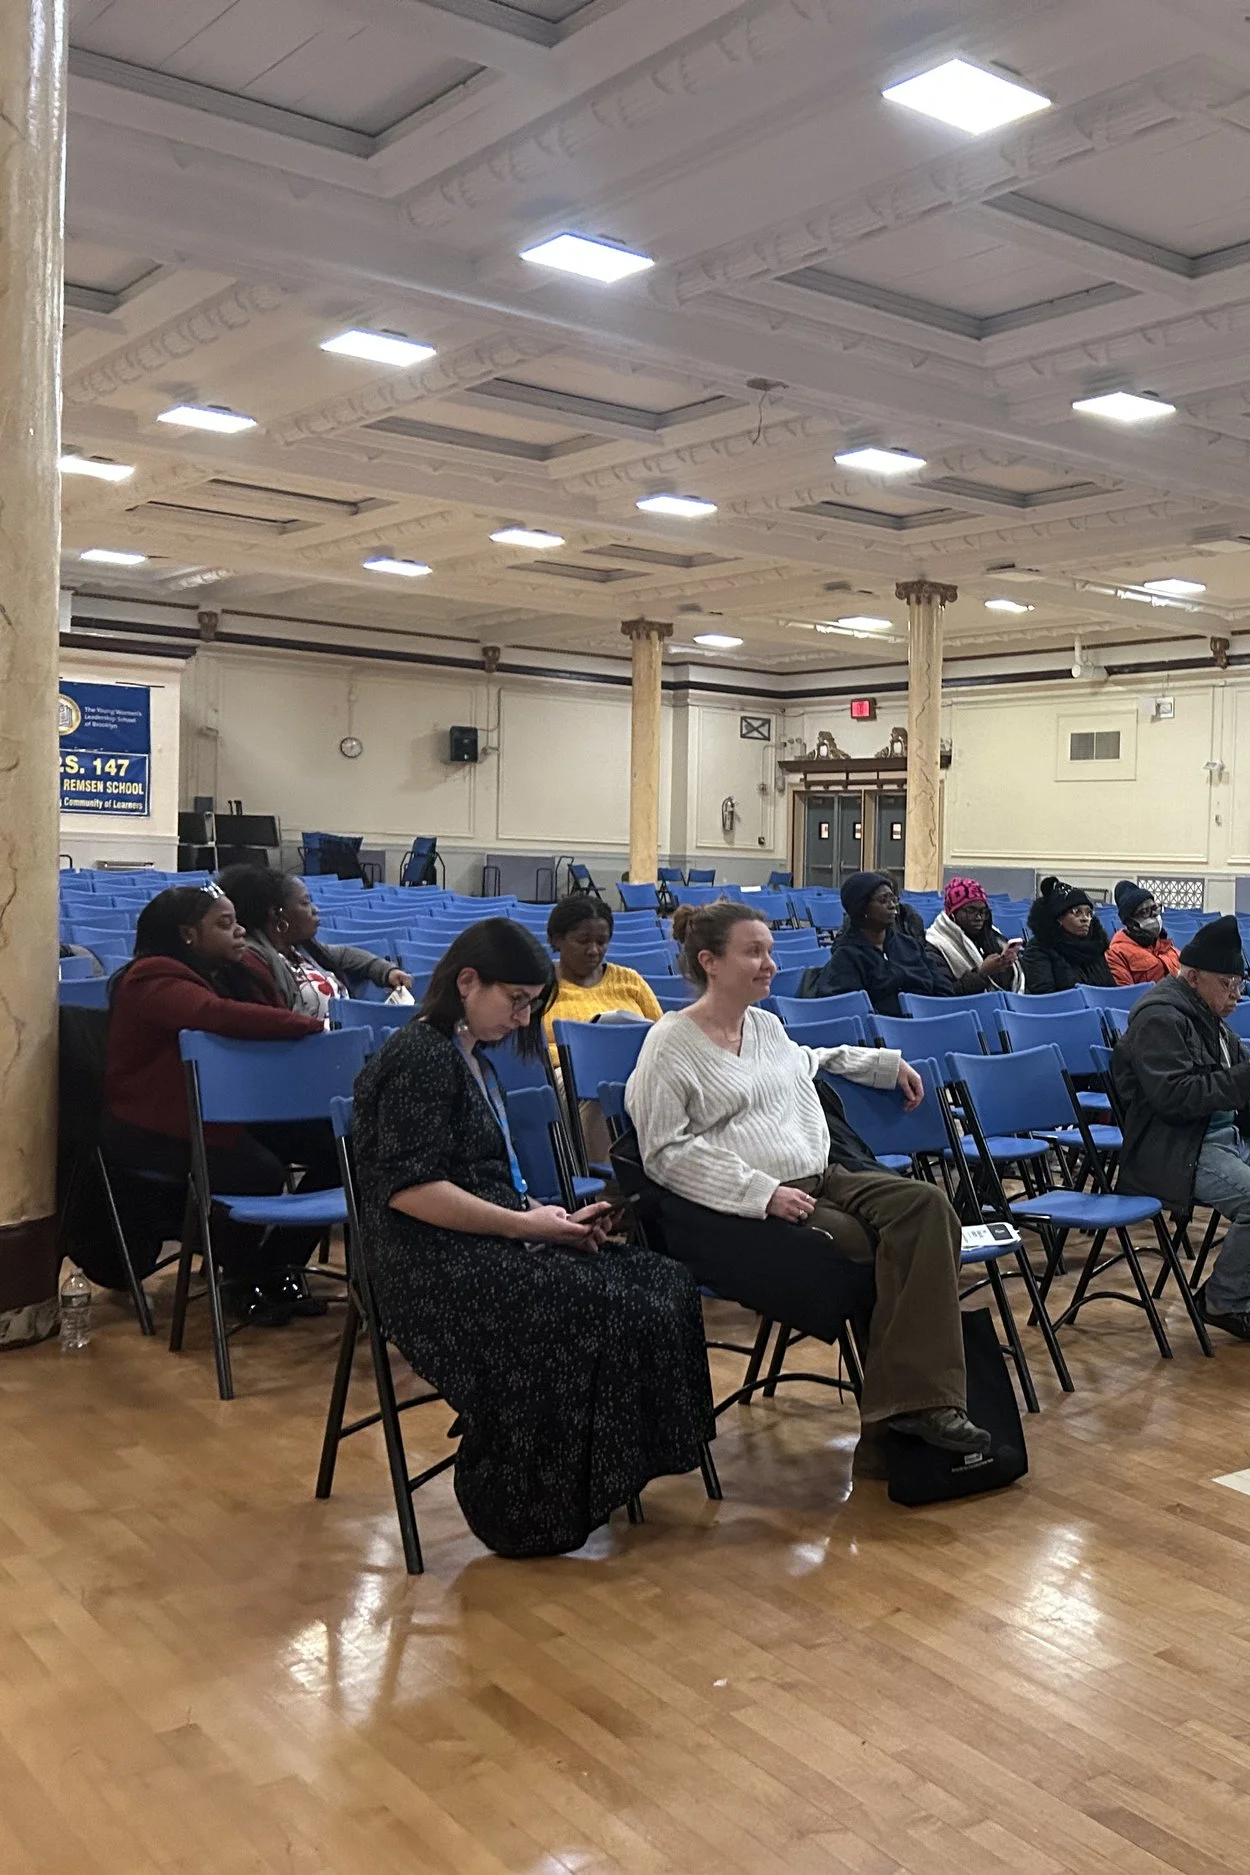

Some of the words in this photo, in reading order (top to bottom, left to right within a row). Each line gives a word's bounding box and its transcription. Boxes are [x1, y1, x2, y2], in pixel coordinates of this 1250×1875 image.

[96, 707, 115, 716] Young
[84, 714, 116, 722] Leadership
[92, 721, 118, 729] Brooklyn
[92, 757, 130, 776] 147
[63, 779, 104, 792] REMSEN
[106, 781, 144, 795] SCHOOL
[64, 797, 103, 809] Community
[104, 800, 112, 808] of
[113, 800, 143, 809] Learners
